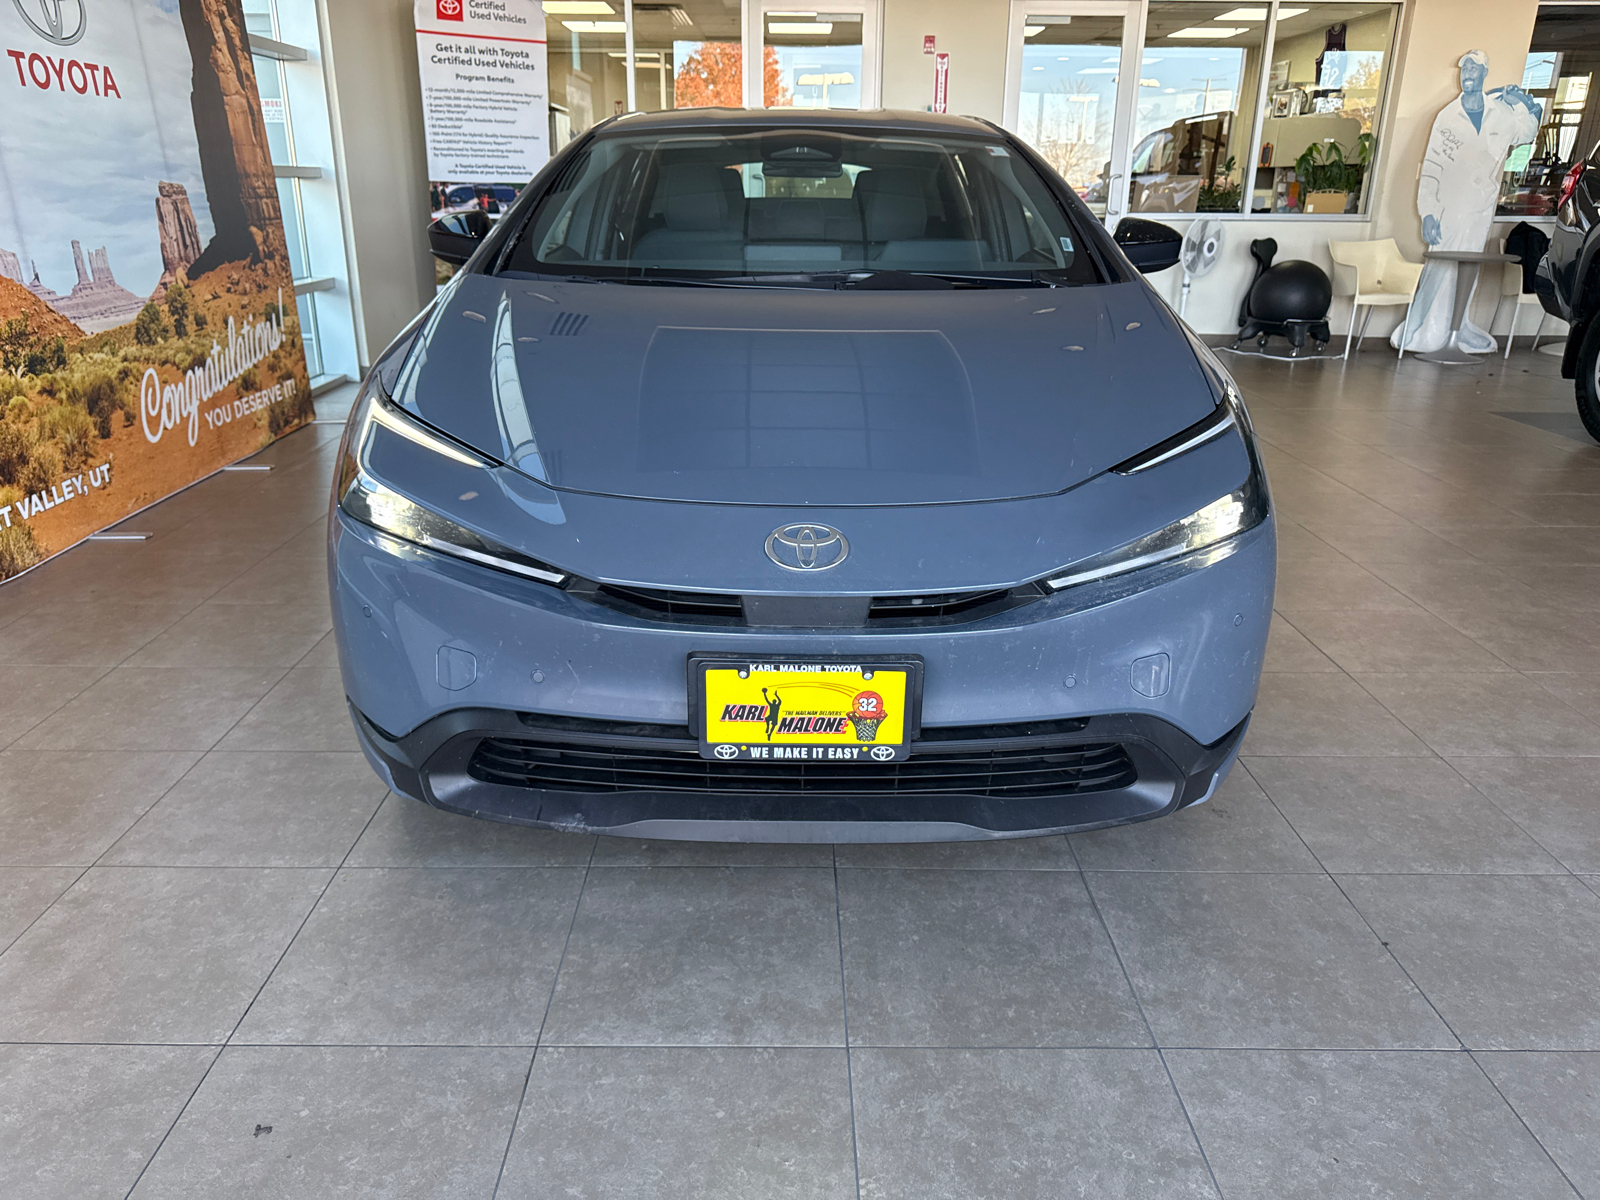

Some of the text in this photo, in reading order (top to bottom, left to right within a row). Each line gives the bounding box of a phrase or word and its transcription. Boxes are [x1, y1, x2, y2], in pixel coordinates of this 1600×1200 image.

[469, 0, 505, 11] Certified
[470, 10, 526, 24] Used Vehicles
[436, 43, 530, 60] Get it all with Toyota
[430, 55, 535, 71] Certified Used Vehicles
[6, 49, 122, 100] TOYOTA
[456, 73, 514, 84] Program Benefits
[140, 287, 287, 447] Congratulations!
[204, 379, 297, 430] YOU DESERVE IT!
[15, 474, 89, 520] VALLEY,
[89, 462, 110, 488] UT
[749, 664, 863, 673] KARL MALONE TOYOTA
[858, 697, 877, 712] 32
[720, 704, 768, 722] KARL
[776, 717, 848, 734] MALONE
[751, 747, 859, 759] WE MAKE IT EASY
